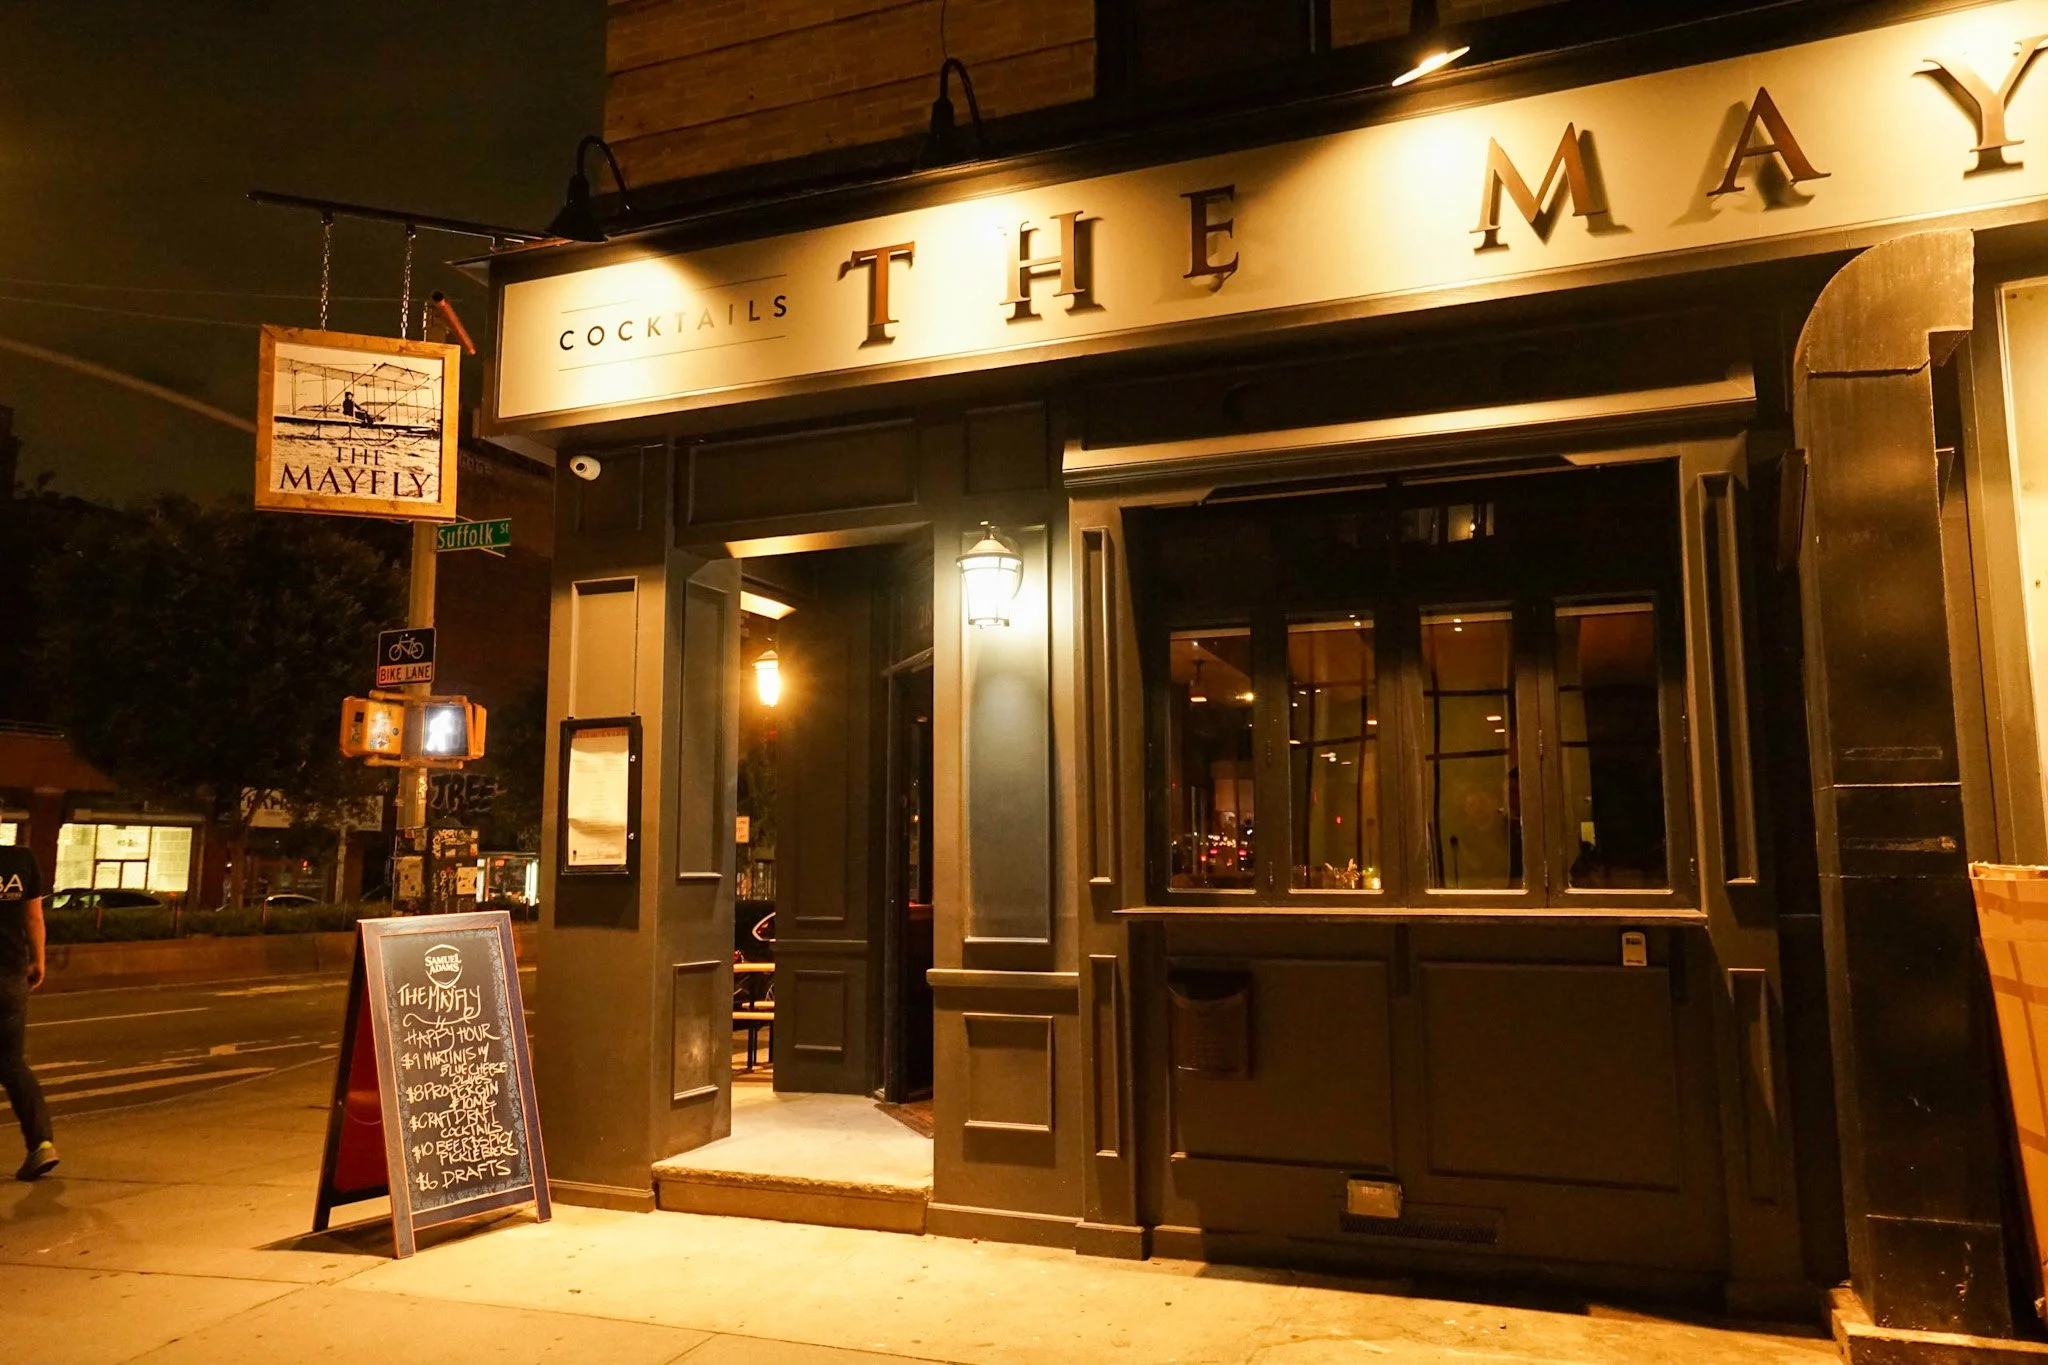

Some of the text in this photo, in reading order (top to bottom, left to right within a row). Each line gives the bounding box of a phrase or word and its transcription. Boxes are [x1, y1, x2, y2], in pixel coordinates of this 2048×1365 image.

[850, 34, 2048, 327] THE MAY
[558, 294, 788, 351] COCKTAILS
[335, 446, 385, 467] THE
[279, 463, 432, 499] MAYFLY
[438, 523, 493, 549] Suffolk
[380, 665, 430, 682] BIKE LANE
[424, 953, 462, 967] SAMUEL
[429, 963, 460, 975] ADAMS
[397, 983, 428, 1007] THE
[403, 1023, 500, 1053] HAPPY HOUR
[423, 1046, 477, 1070] MARTINIS
[441, 1160, 512, 1189] DRAFTS
